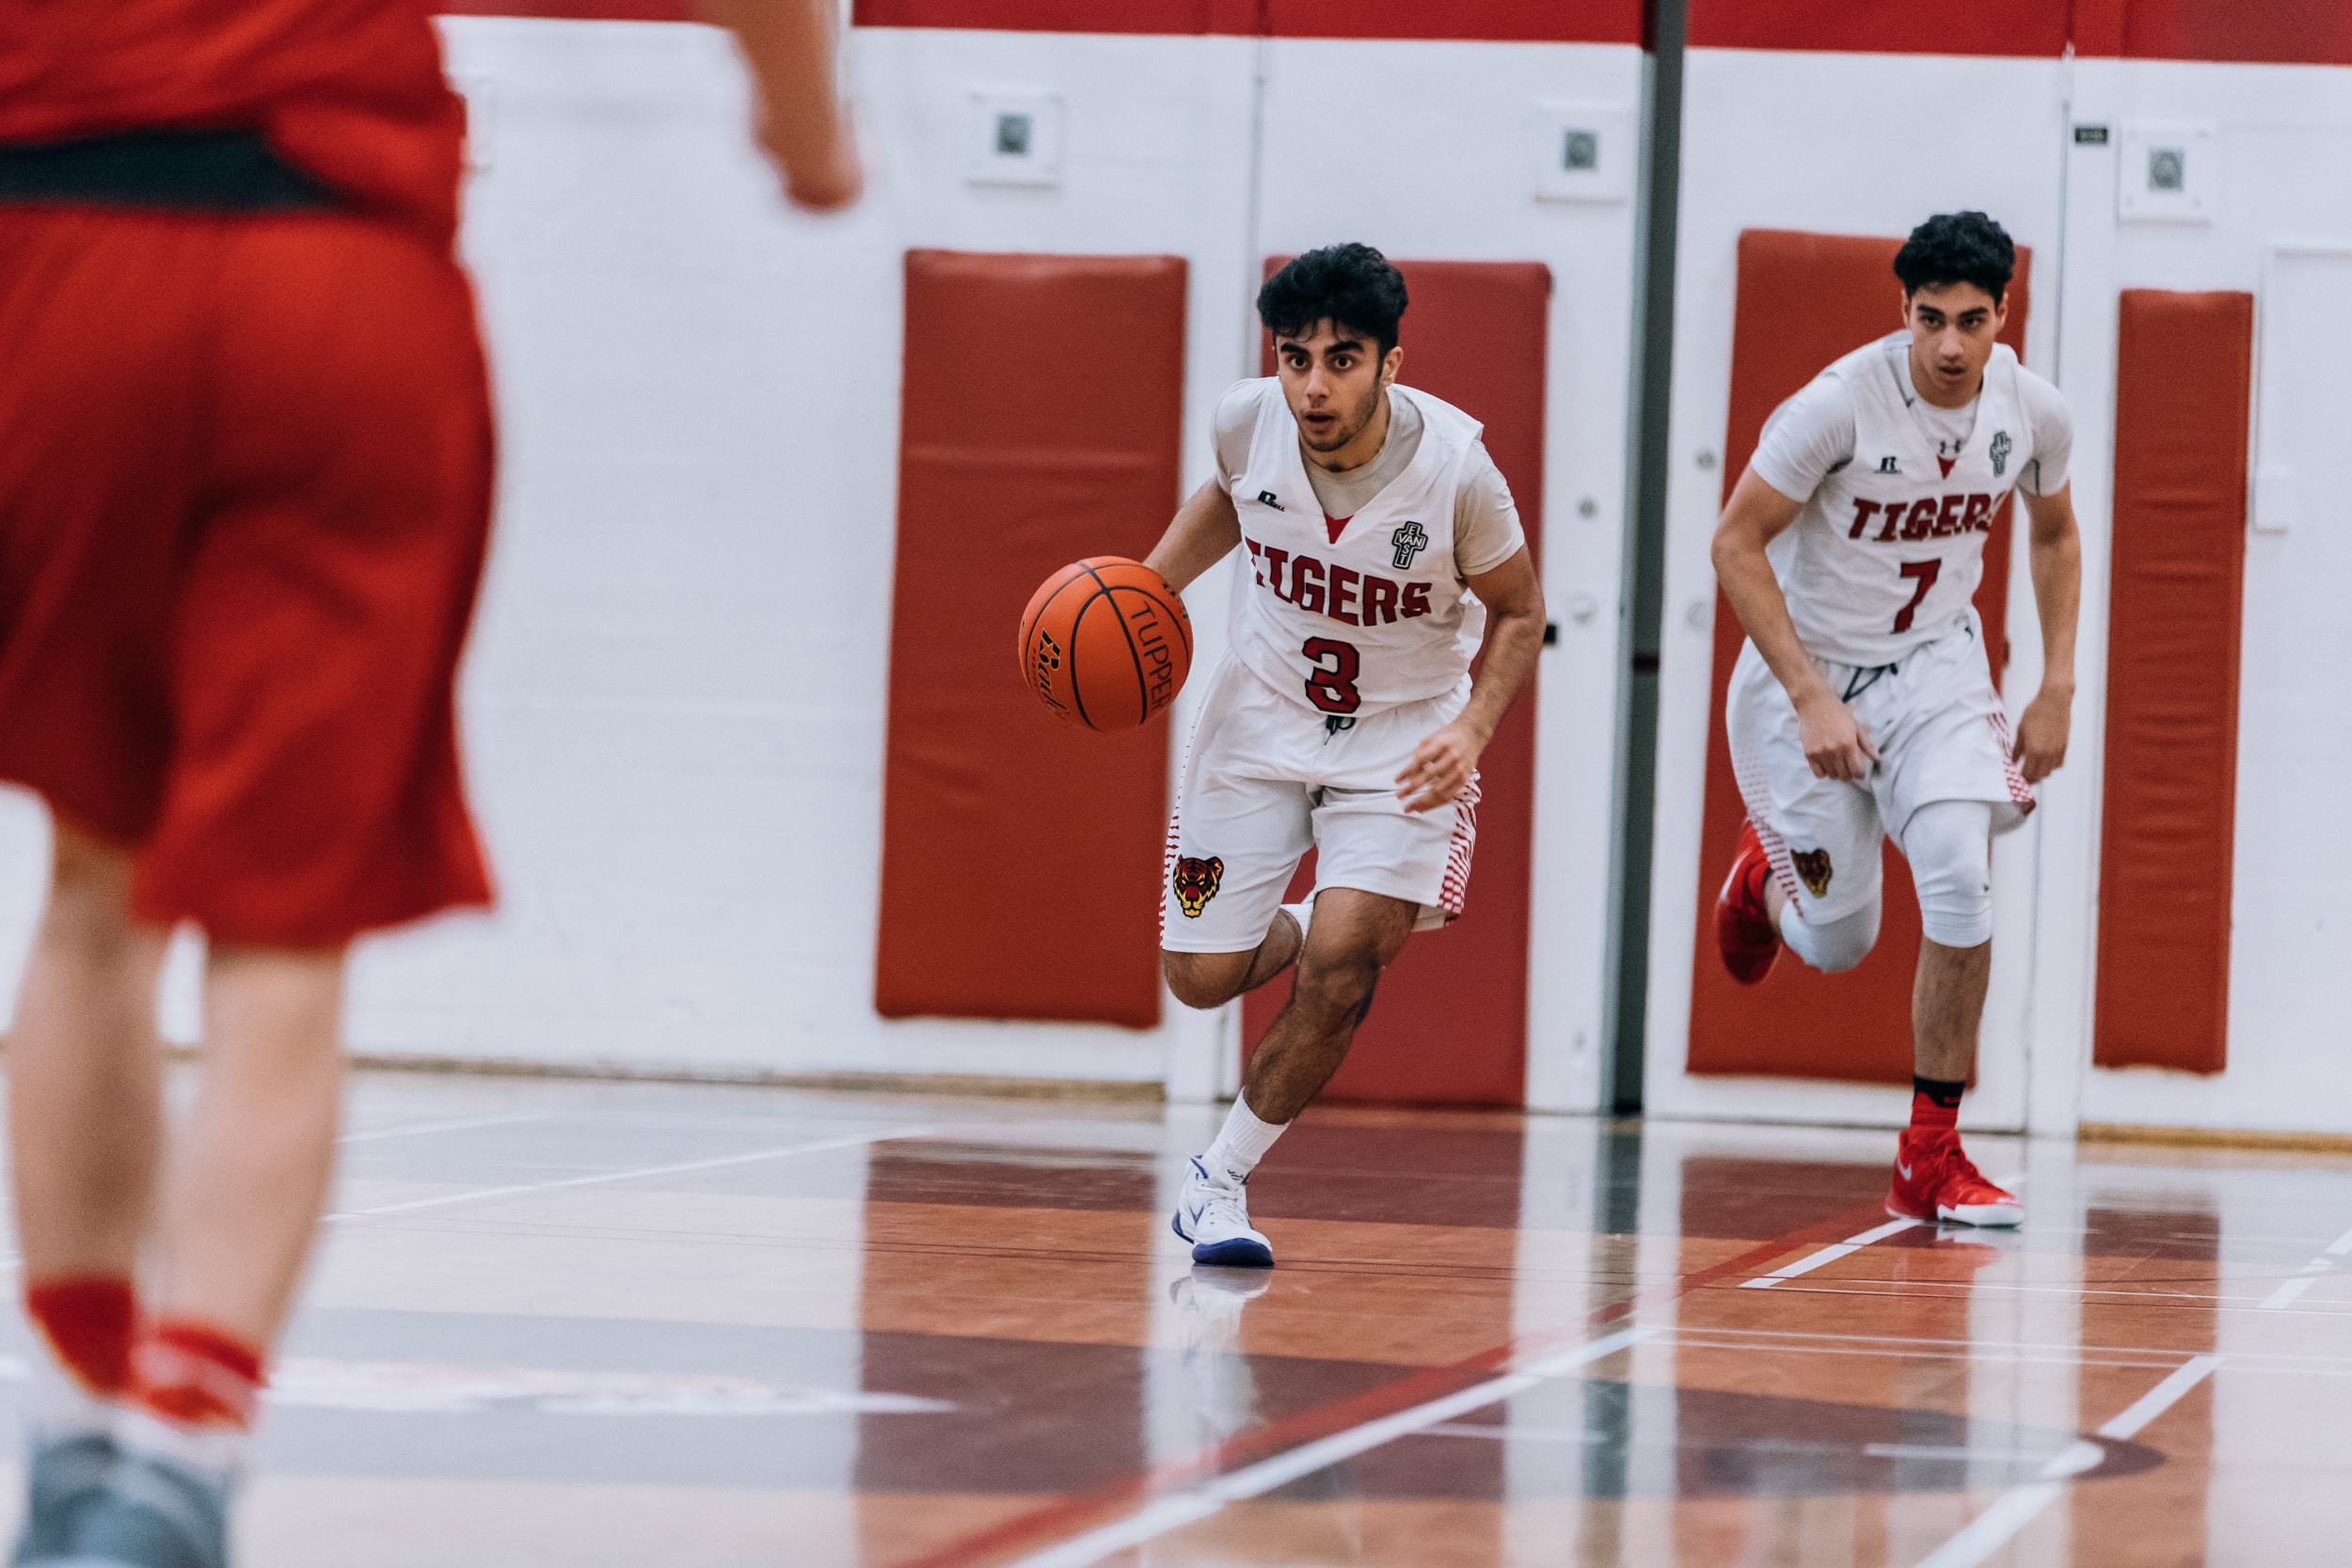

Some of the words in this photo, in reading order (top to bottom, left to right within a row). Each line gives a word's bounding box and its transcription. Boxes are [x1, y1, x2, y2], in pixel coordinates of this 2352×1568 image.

[1891, 558, 1942, 635] 7
[1037, 626, 1070, 719] Bad
[1130, 600, 1173, 712] TUPPER
[1301, 636, 1361, 714] 3
